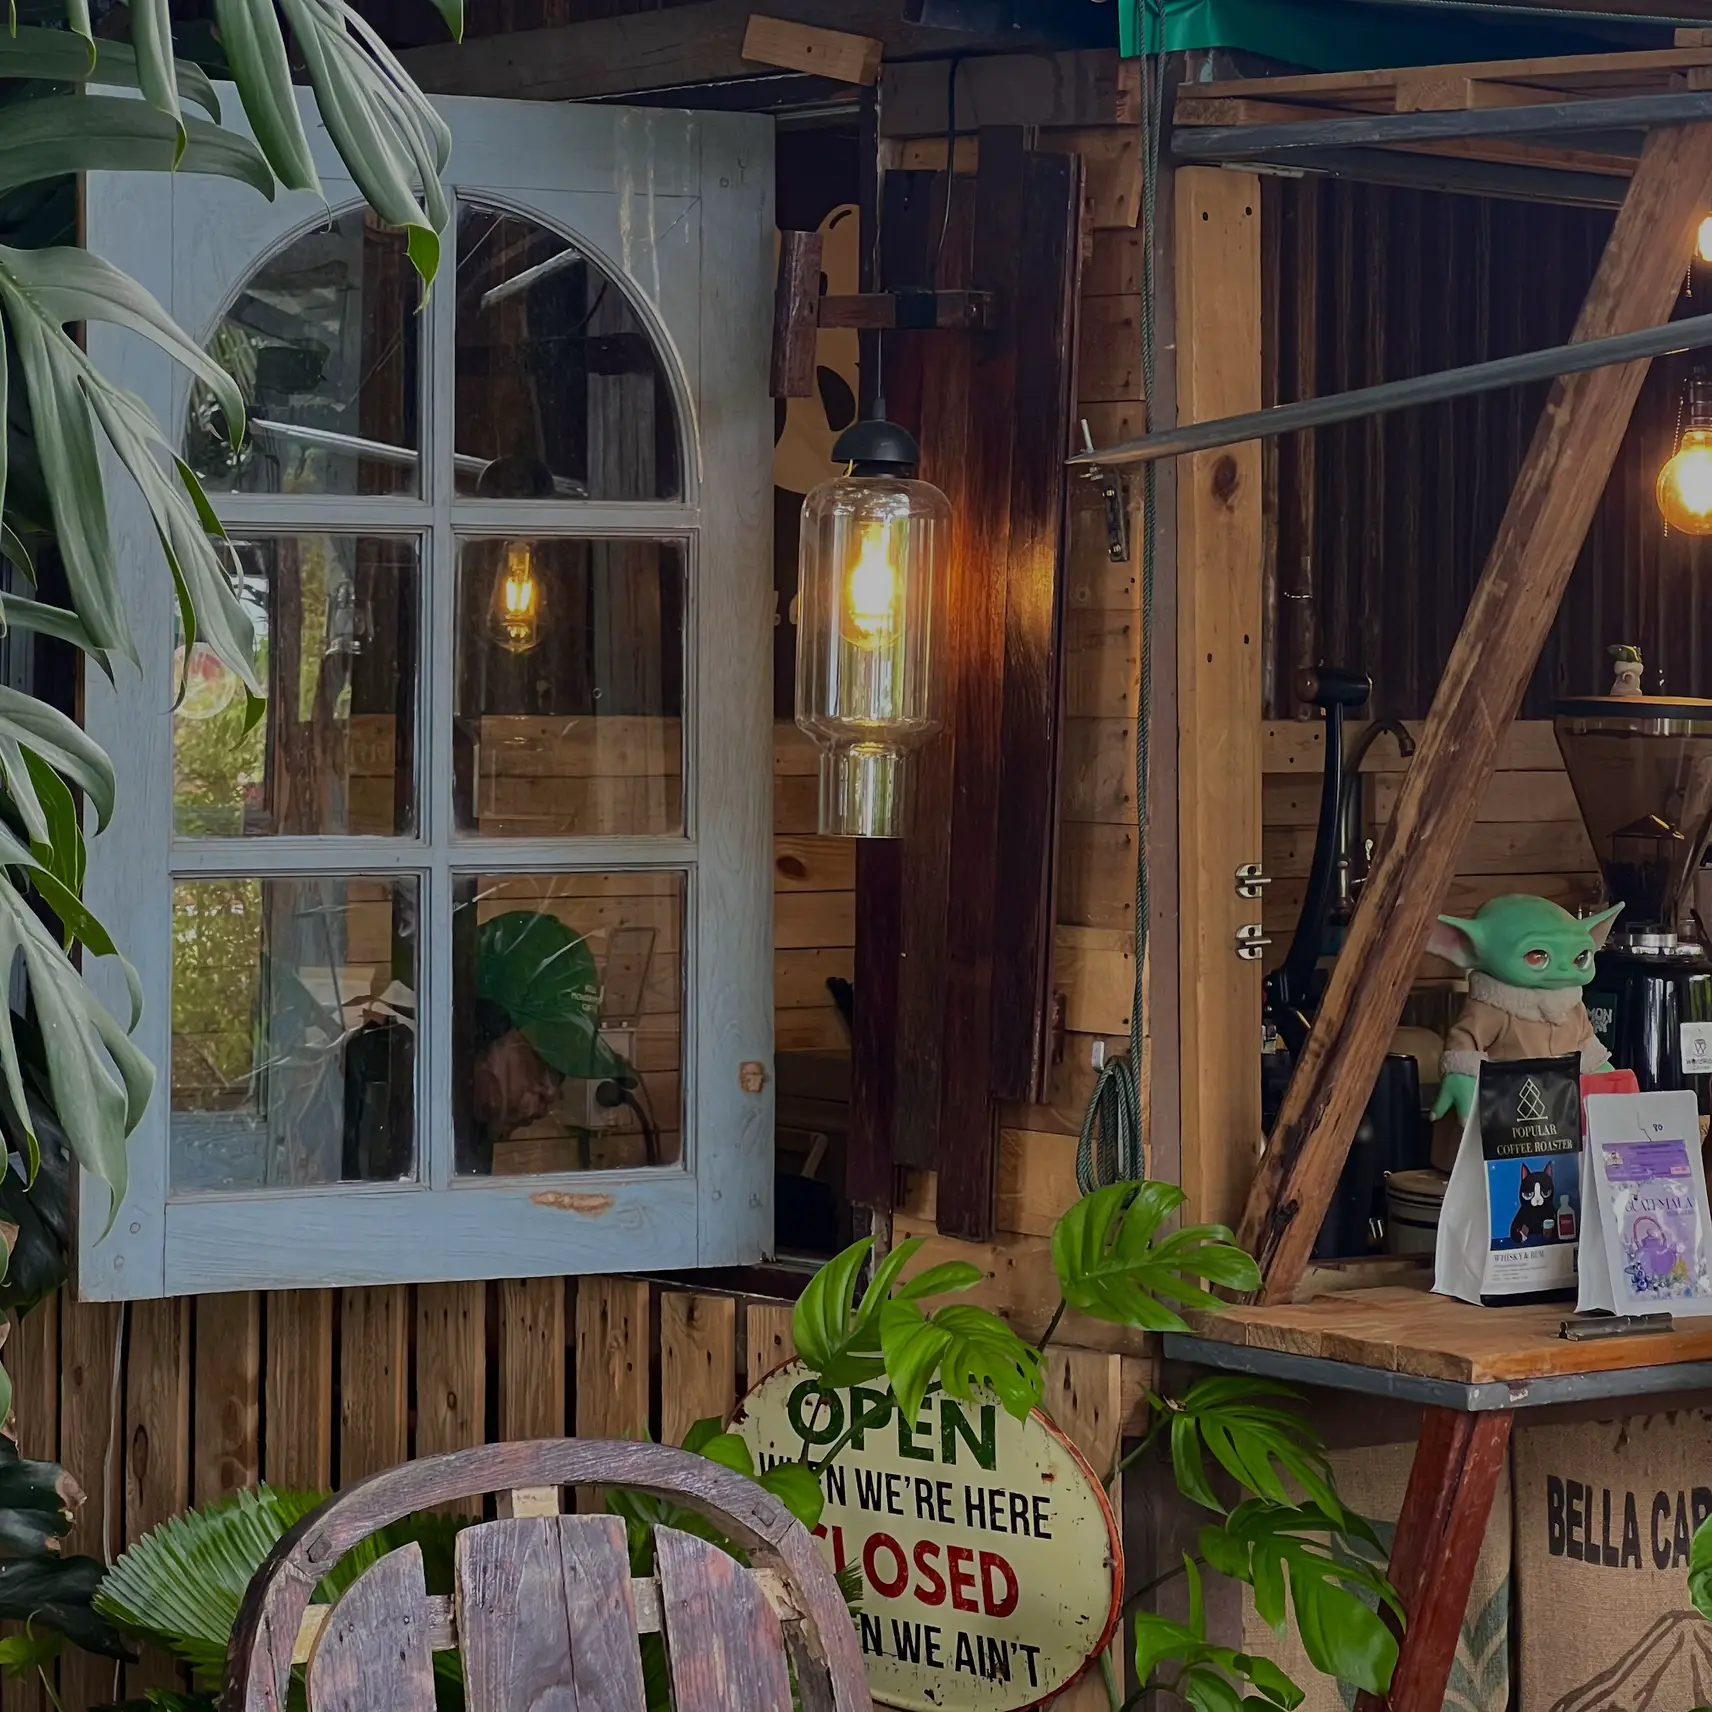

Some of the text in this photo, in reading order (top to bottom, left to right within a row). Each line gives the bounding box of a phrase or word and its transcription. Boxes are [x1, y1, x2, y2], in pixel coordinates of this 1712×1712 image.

[1497, 1139, 1573, 1155] COFFEE ROASTER
[1512, 1124, 1557, 1138] POPULAR
[787, 1379, 996, 1471] OPEN
[964, 1485, 1052, 1540] HERE
[1547, 1474, 1643, 1569] BELLA
[811, 1523, 1019, 1618] LOSED
[891, 1618, 945, 1669] WE
